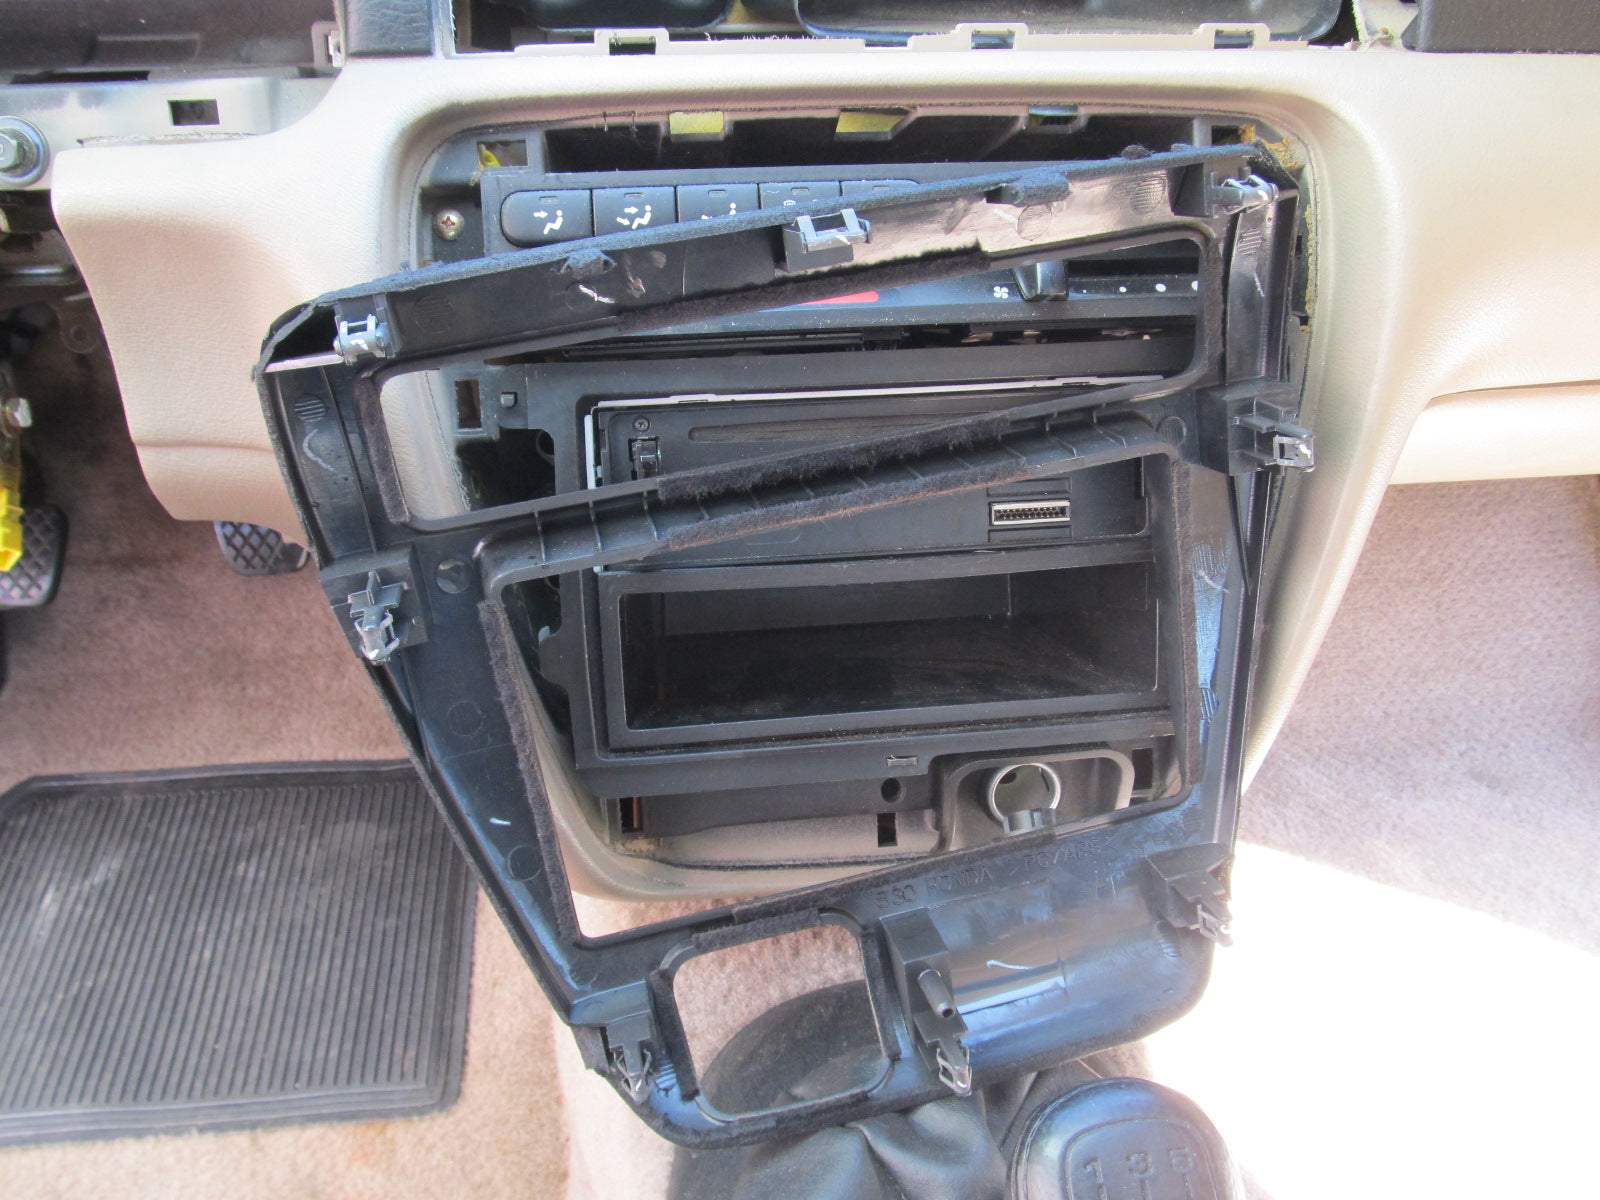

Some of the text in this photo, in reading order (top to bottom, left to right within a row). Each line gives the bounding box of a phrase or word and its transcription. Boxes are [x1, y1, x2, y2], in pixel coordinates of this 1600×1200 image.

[1083, 1145, 1193, 1184] 1 3 5
